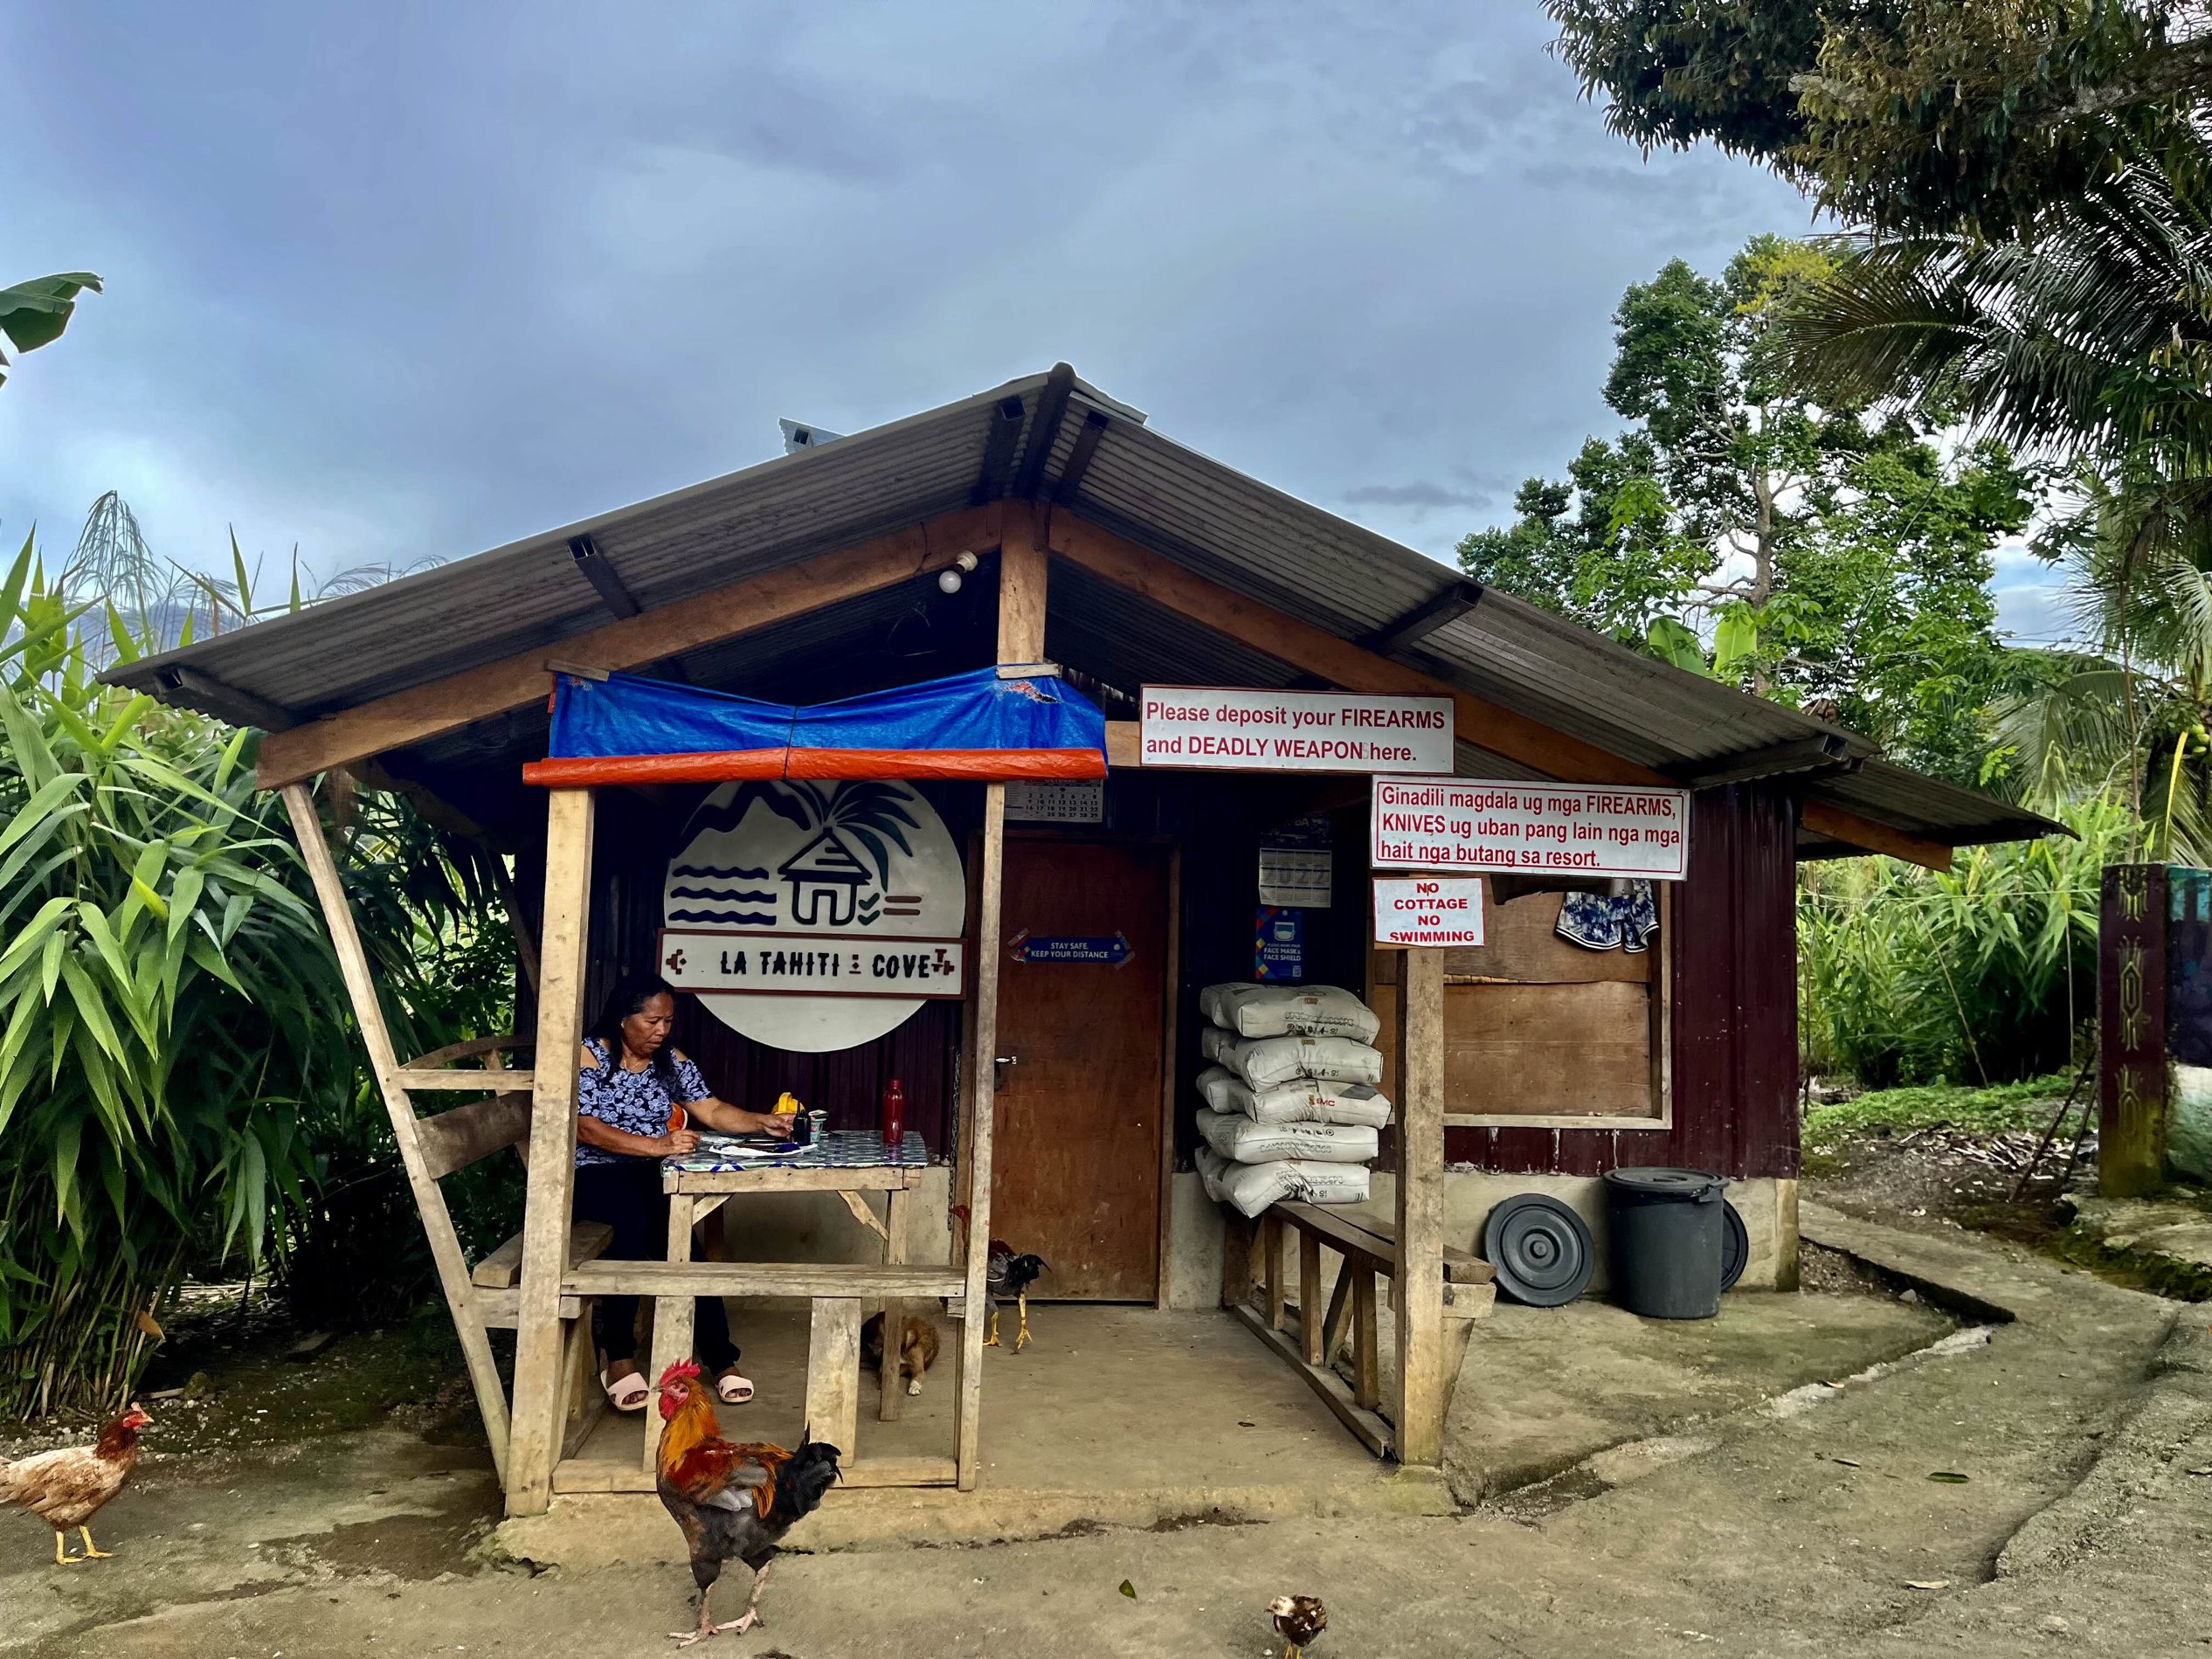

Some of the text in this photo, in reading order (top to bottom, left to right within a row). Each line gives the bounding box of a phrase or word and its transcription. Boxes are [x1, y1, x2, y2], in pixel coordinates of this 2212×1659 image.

[1147, 702, 1445, 729] Please deposit your FIREARMS
[1147, 736, 1180, 754] and
[1189, 737, 1268, 756] DEADLY
[1370, 743, 1416, 761] here.
[1382, 786, 1676, 820] Ginadili magdala ug mga FIREARMS,
[1383, 814, 1680, 847] KNIVES ug uban pang lain nga mga
[1381, 841, 1600, 867] hait nga butang sa resort.
[1417, 883, 1439, 894] NO
[1394, 898, 1467, 909] COTTAGE
[1418, 915, 1440, 926] NO
[1390, 931, 1474, 942] SWIMMING
[721, 951, 930, 978] LA TAHITI COVE
